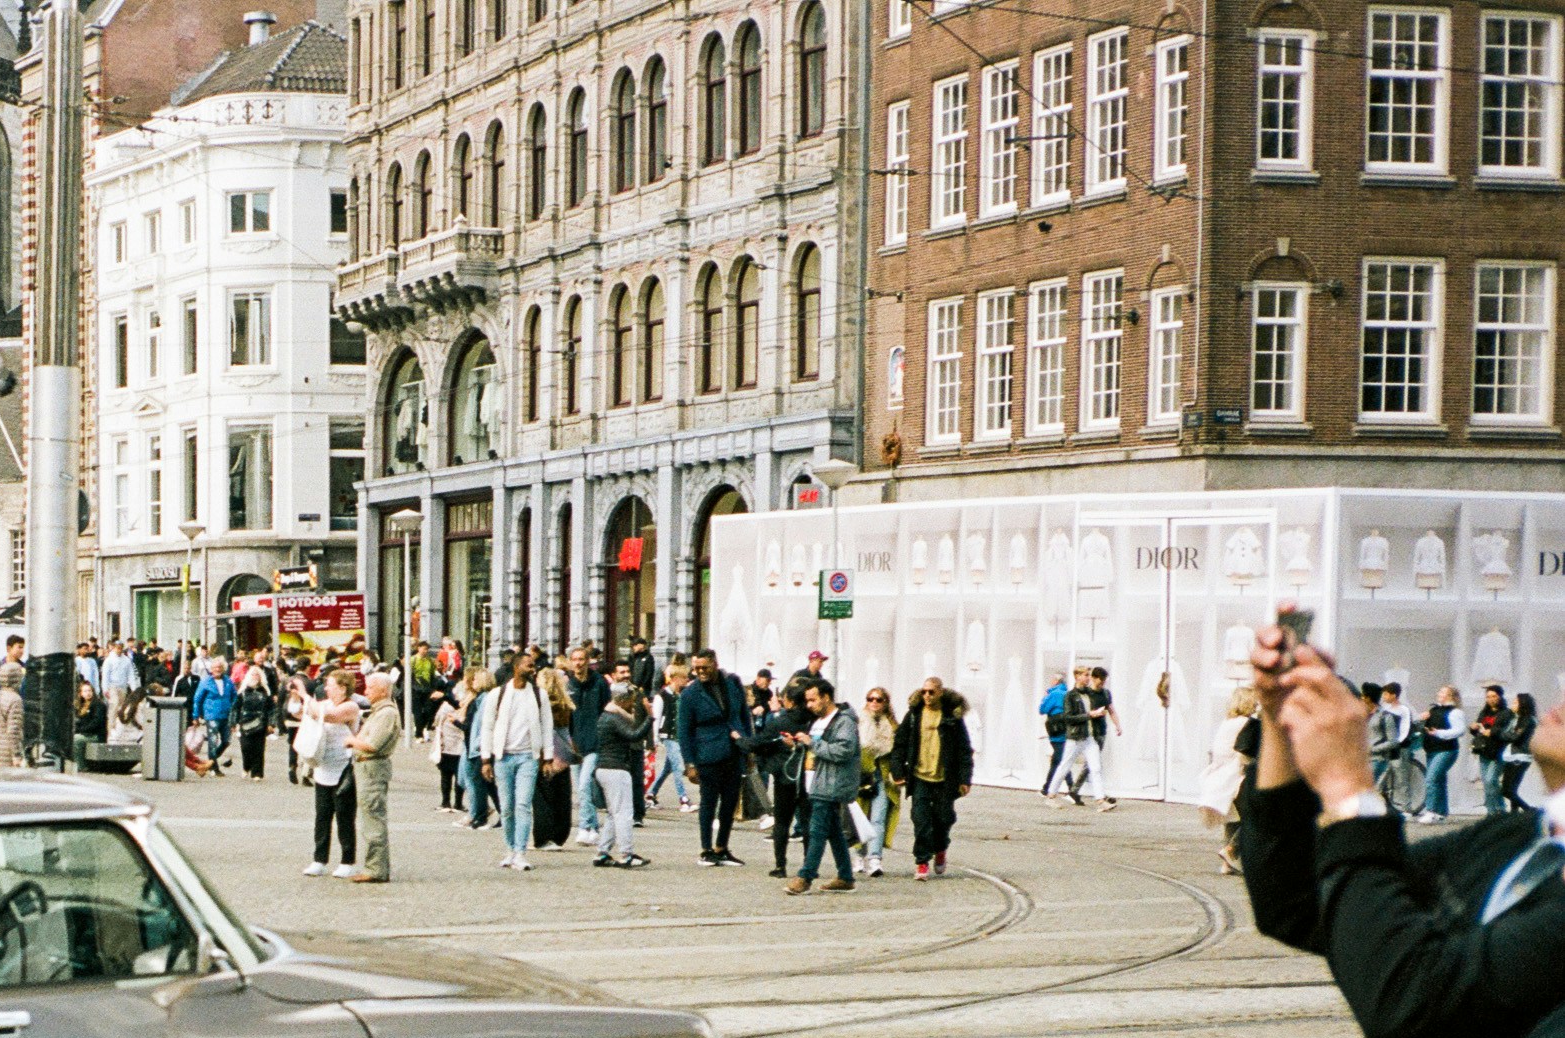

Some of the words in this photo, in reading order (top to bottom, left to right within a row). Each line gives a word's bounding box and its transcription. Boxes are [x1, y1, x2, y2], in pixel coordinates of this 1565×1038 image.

[857, 551, 891, 572] DIOR
[1135, 546, 1199, 570] DIOR
[278, 596, 338, 609] HOTDOGS
